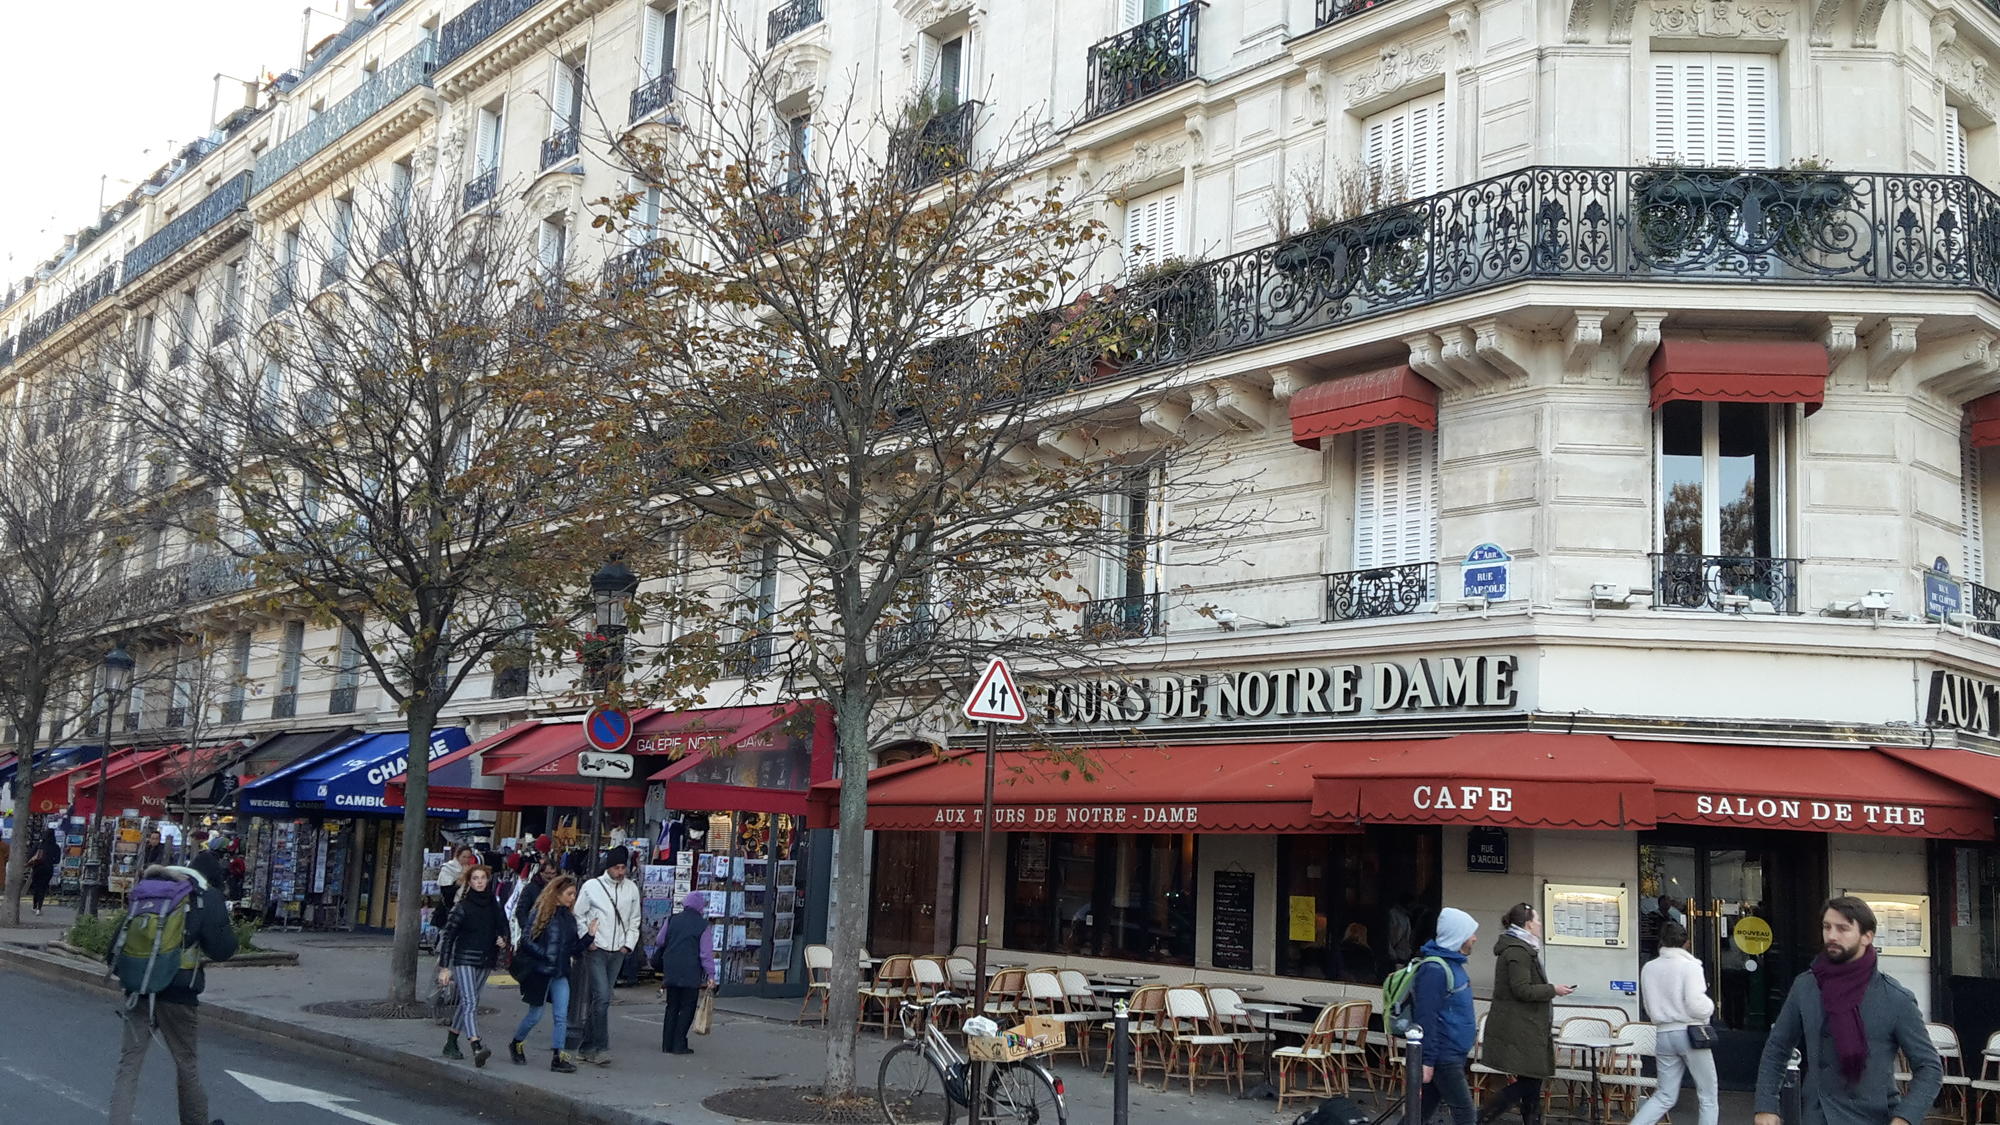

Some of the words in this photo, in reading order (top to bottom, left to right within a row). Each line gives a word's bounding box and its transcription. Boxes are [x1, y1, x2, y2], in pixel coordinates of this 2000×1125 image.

[1477, 572, 1493, 581] RUE
[1465, 584, 1505, 595] D'ARCOLE
[1157, 675, 1206, 719] DE
[1216, 664, 1362, 718] NOTRE
[1371, 655, 1518, 711] DAME
[1928, 671, 1990, 733] AUX
[367, 739, 449, 785] CHAGE
[249, 799, 291, 809] WECHSEL
[1413, 785, 1512, 812] CAFE
[935, 809, 965, 823] AUX
[974, 809, 1026, 823] TURS
[1034, 808, 1057, 822] DE
[1066, 807, 1127, 823] NOTRE
[1143, 807, 1198, 823] DAME
[1696, 796, 1800, 819] SALON
[1811, 802, 1852, 822] DE
[1864, 805, 1925, 826] THE
[1480, 844, 1494, 854] RUE
